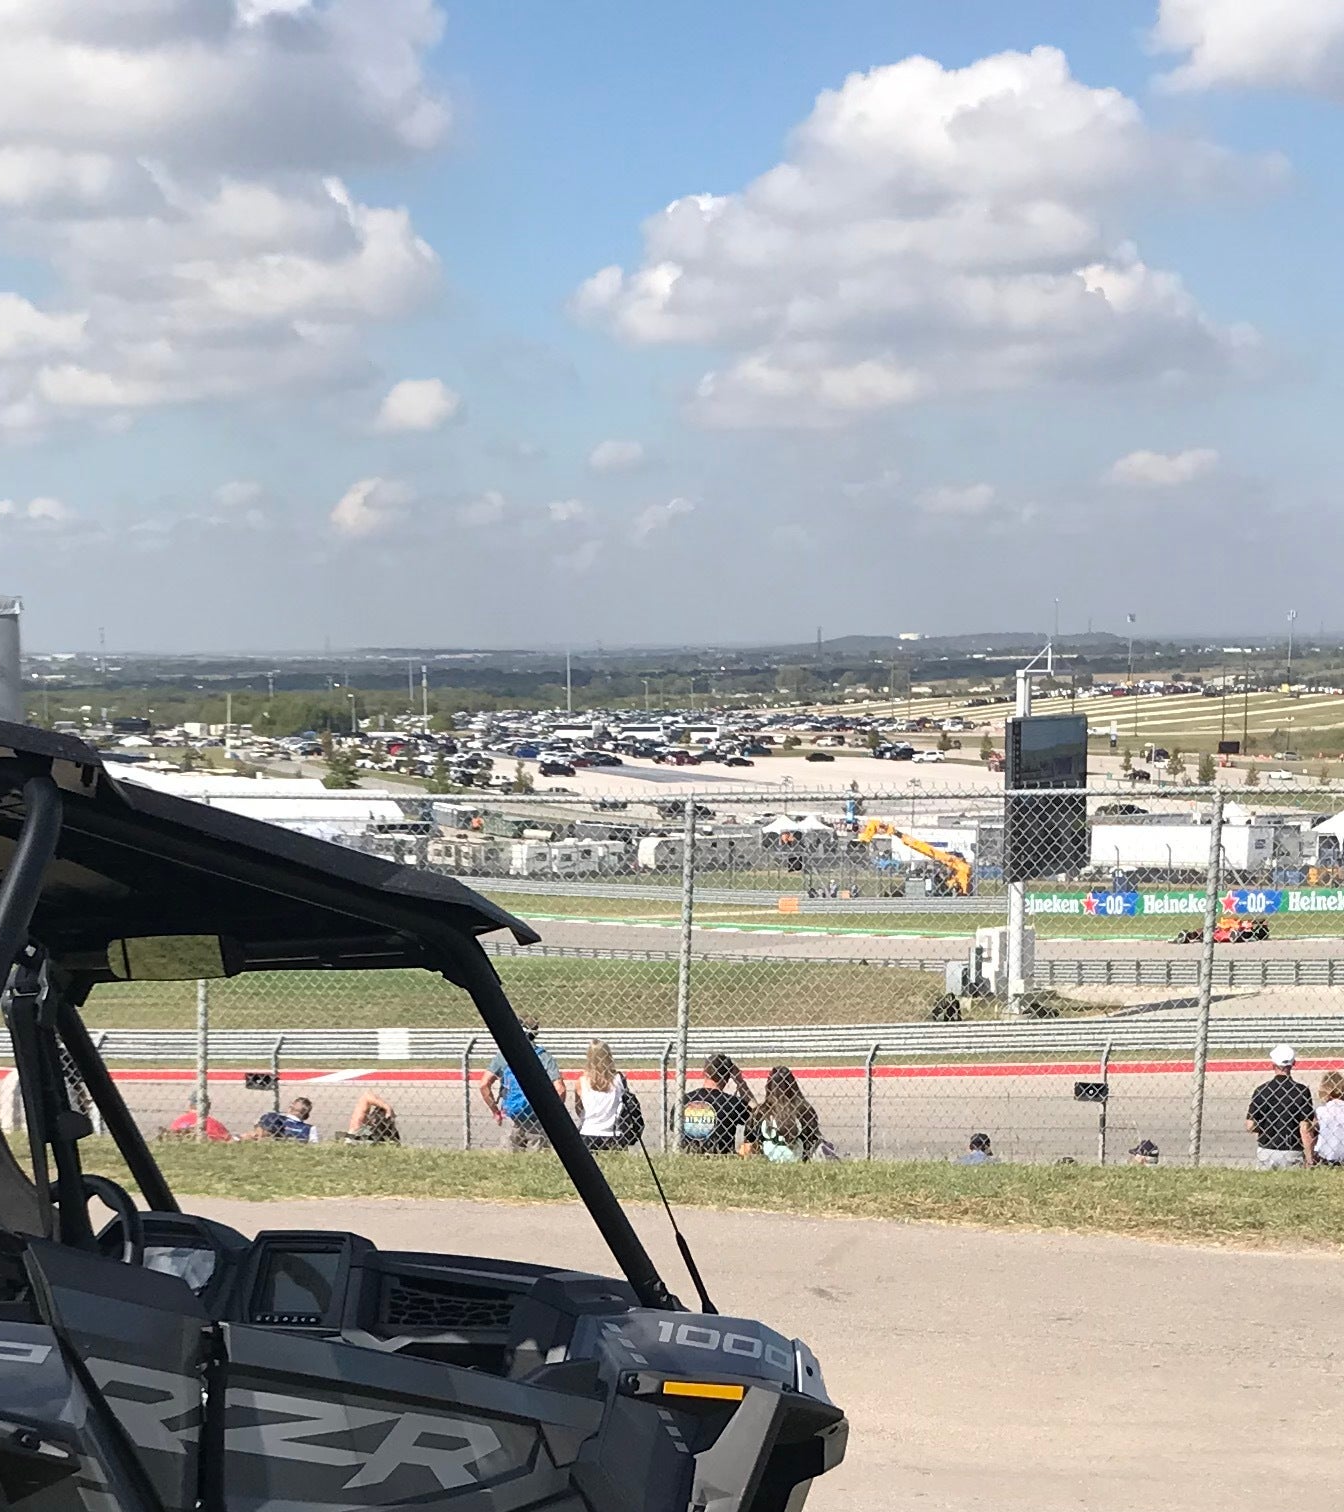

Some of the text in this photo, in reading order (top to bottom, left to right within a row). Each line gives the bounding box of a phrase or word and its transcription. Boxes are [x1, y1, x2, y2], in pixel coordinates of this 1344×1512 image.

[1024, 893, 1080, 914] eineken
[1143, 894, 1219, 914] Heineke
[658, 1320, 795, 1372] 1000
[84, 1356, 502, 1490] RZR
